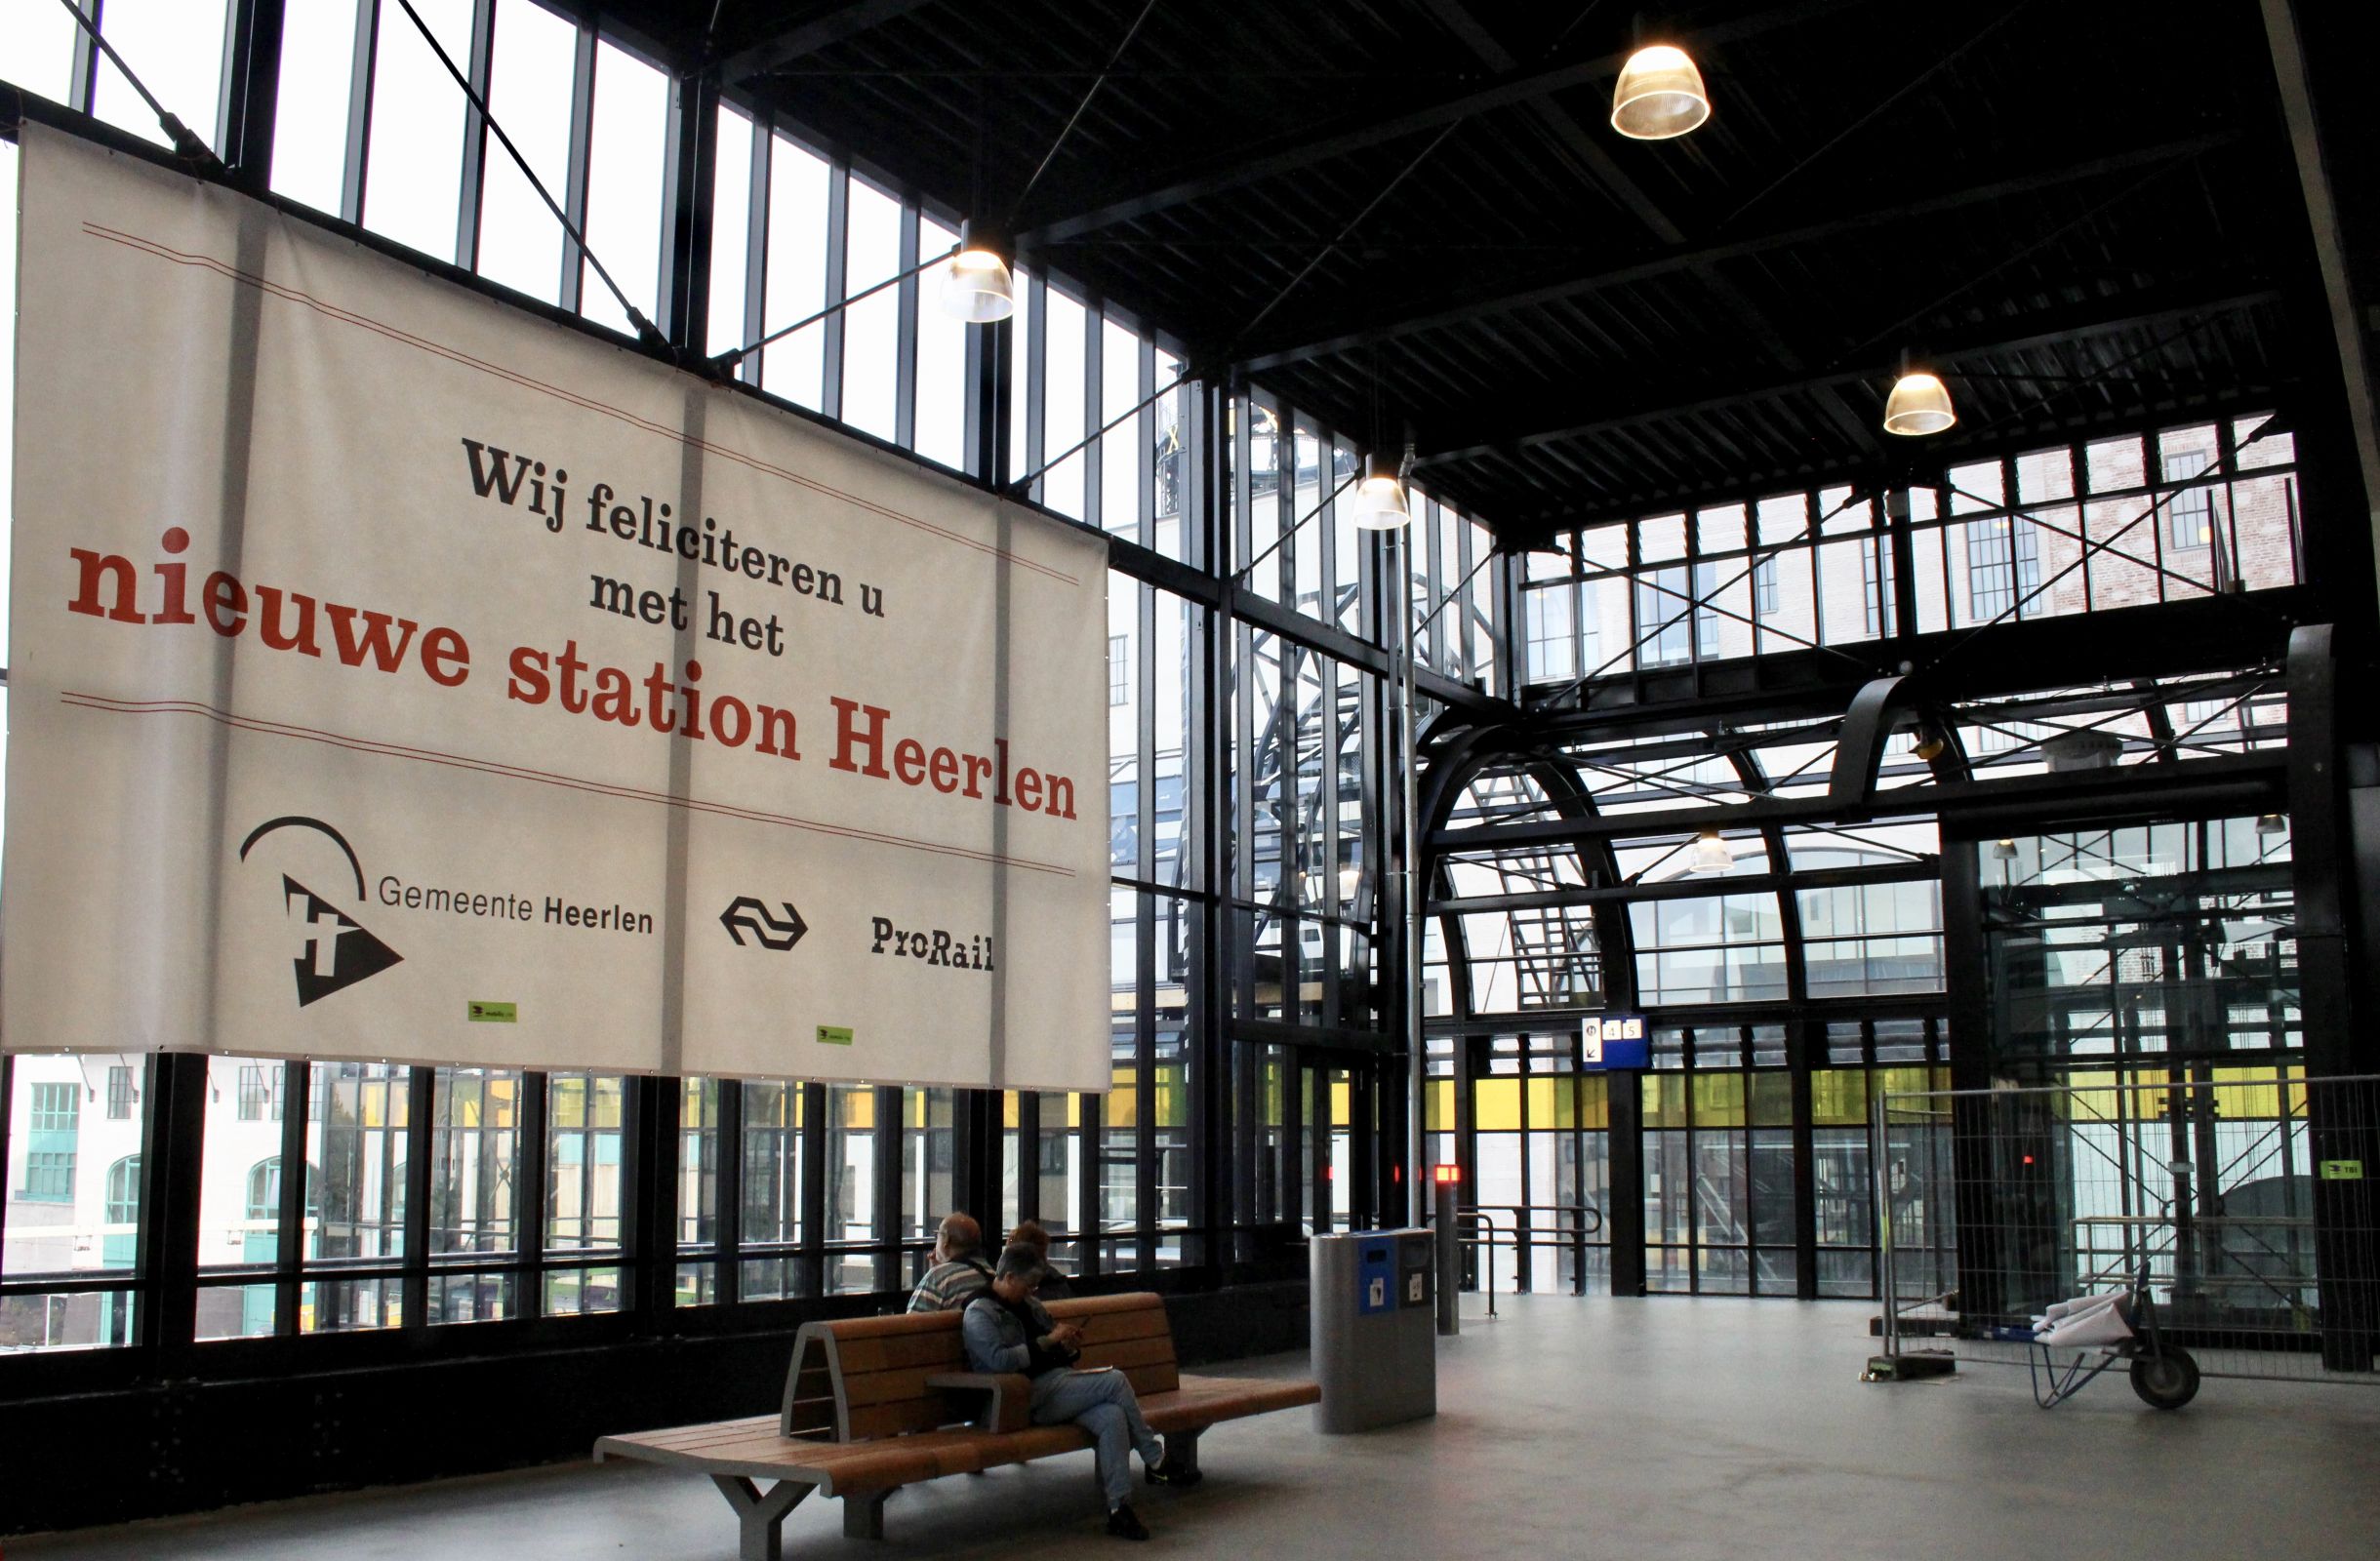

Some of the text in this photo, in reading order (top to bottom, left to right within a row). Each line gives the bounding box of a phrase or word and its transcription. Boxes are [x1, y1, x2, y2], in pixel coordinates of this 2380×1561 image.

[462, 437, 884, 618] Wij feliciteren u
[589, 574, 785, 657] met het
[67, 526, 1078, 821] nieuwe station Heerlen
[379, 875, 653, 935] Gemeente Heerlen
[871, 916, 994, 972] ProRail
